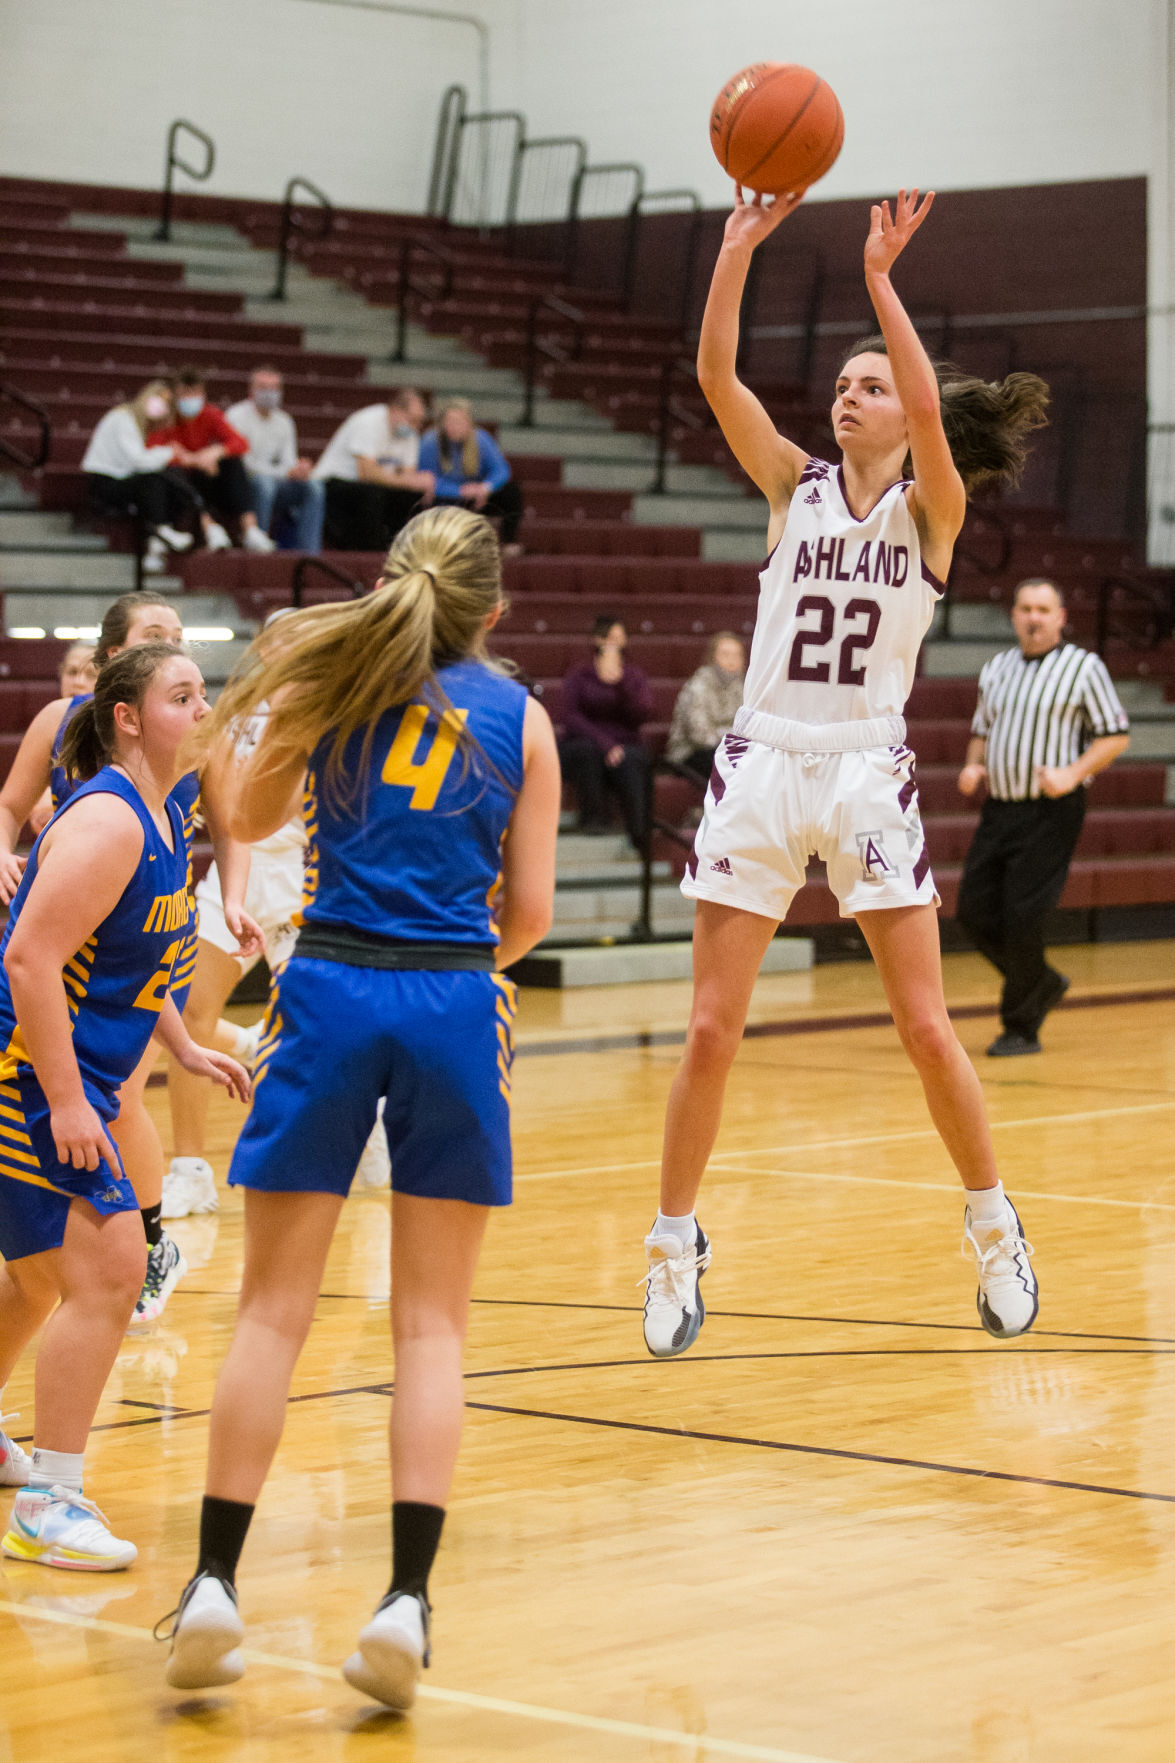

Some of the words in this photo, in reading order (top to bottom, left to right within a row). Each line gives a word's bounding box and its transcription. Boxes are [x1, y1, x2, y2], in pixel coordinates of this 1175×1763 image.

[787, 594, 882, 686] 22
[381, 704, 469, 811] 4
[855, 829, 900, 882] A
